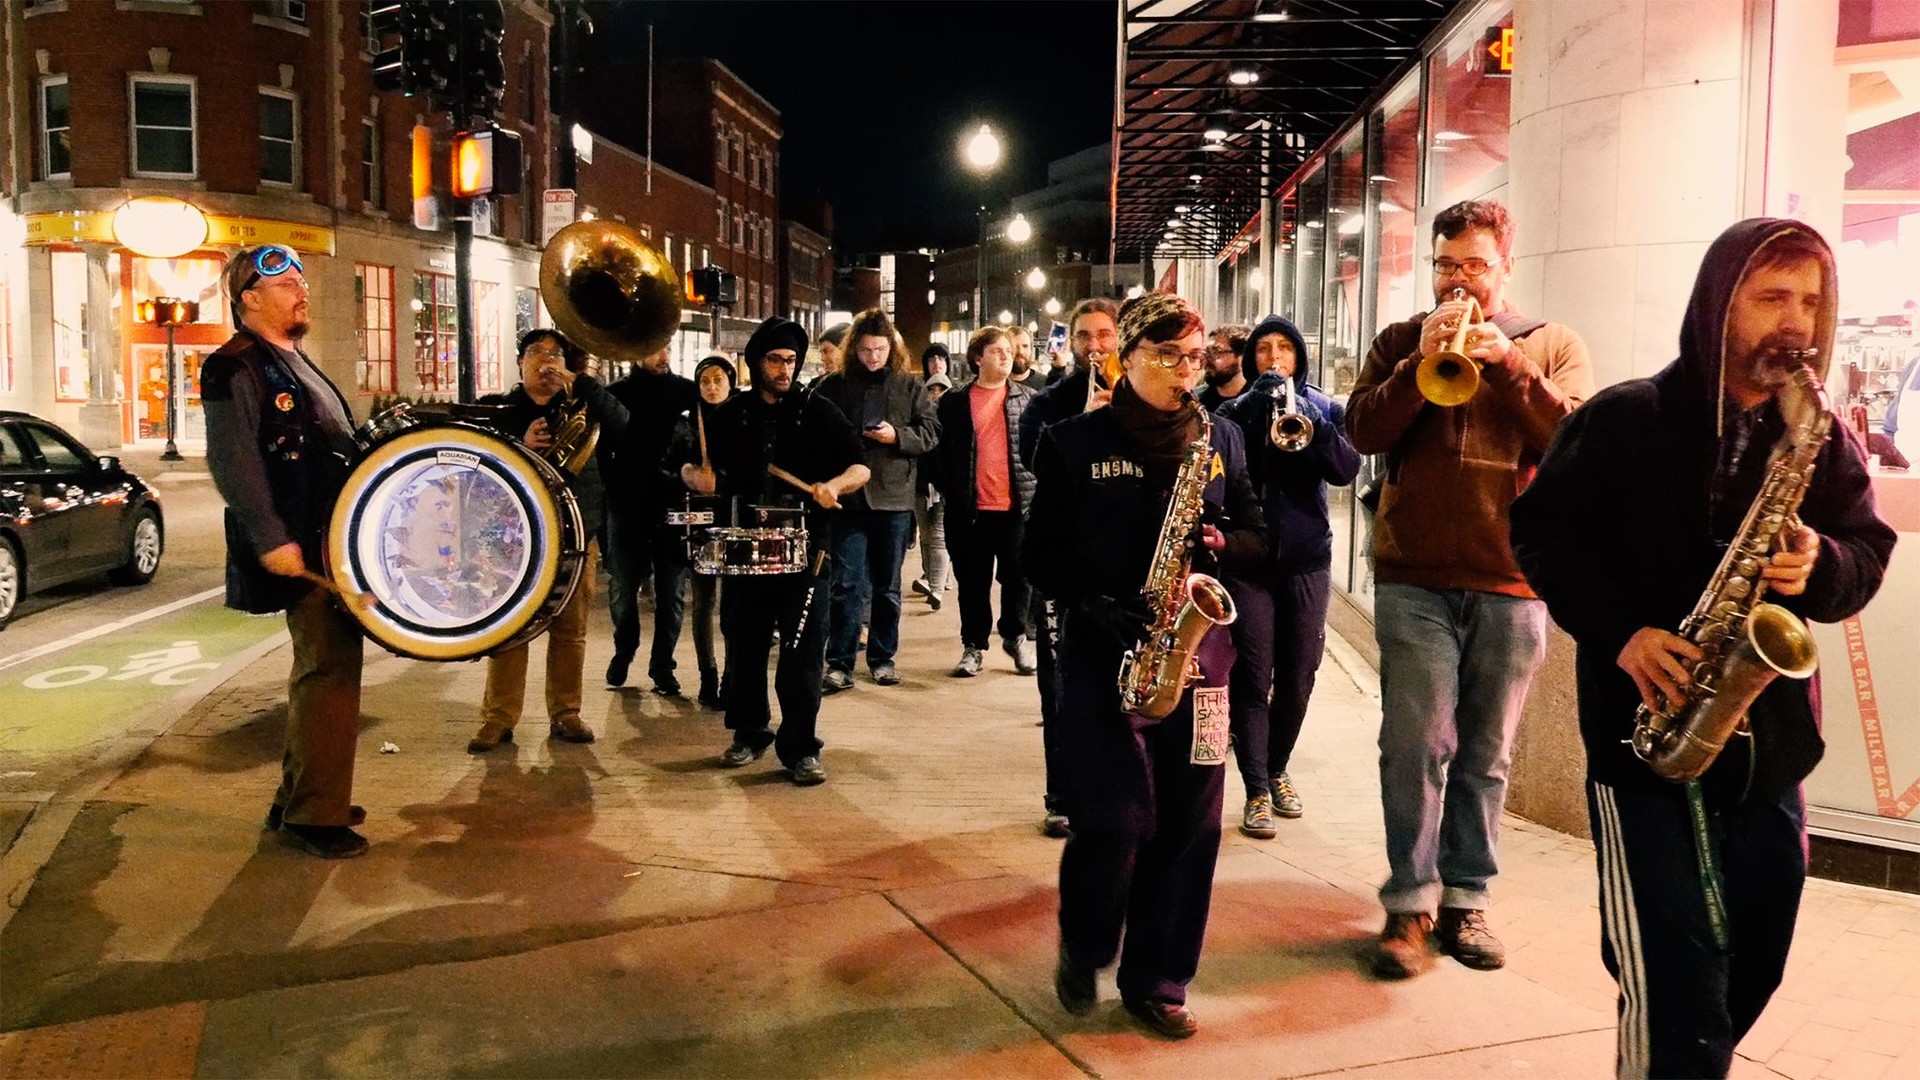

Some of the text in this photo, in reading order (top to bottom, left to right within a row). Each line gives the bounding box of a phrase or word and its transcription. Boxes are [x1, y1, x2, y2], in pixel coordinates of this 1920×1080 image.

[439, 452, 477, 462] AQUARIAN
[1845, 621, 1872, 702] MILK BAR
[1864, 719, 1891, 799] MILK BAR
